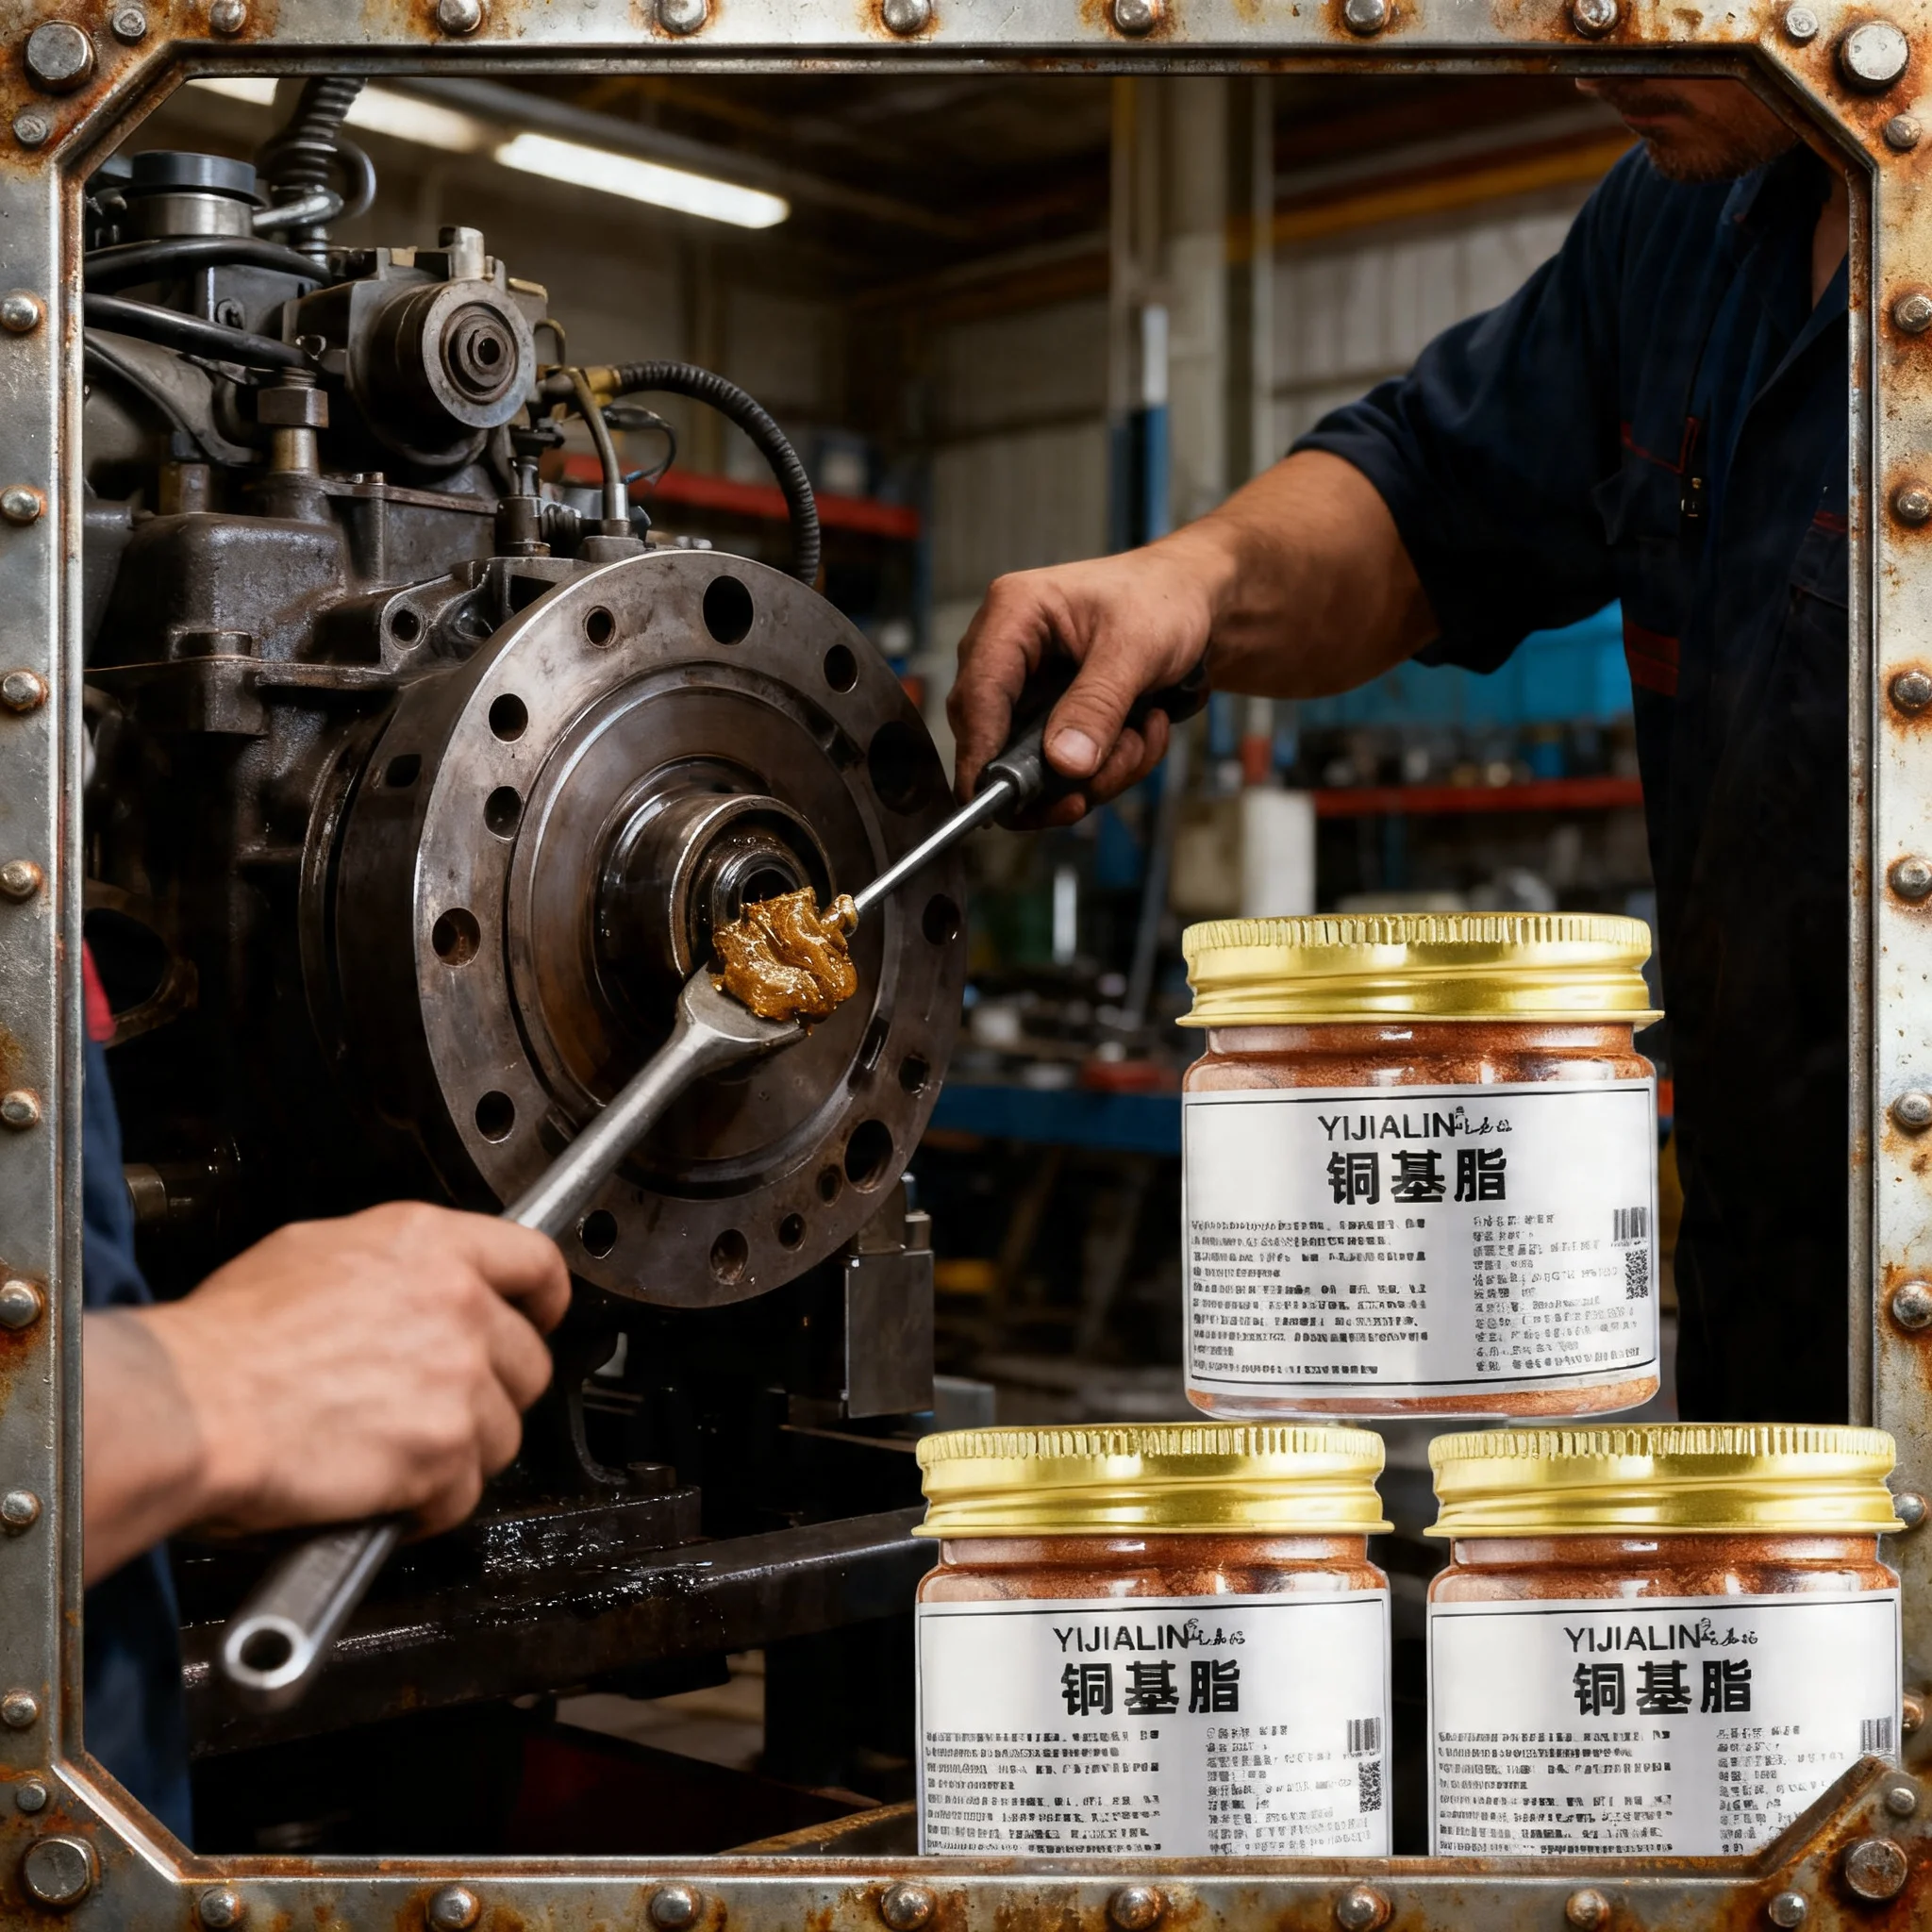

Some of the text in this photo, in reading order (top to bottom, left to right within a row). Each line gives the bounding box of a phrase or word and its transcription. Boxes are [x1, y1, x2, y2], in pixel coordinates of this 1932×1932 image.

[1317, 1111, 1457, 1141] YIJIALIN
[1325, 1147, 1507, 1206] 铜基脂
[1052, 1624, 1190, 1653] YIJIALIN
[1563, 1624, 1702, 1653] YIJIALIN
[1060, 1658, 1241, 1717] 铜基脂
[1572, 1658, 1752, 1717] 铜基脂
